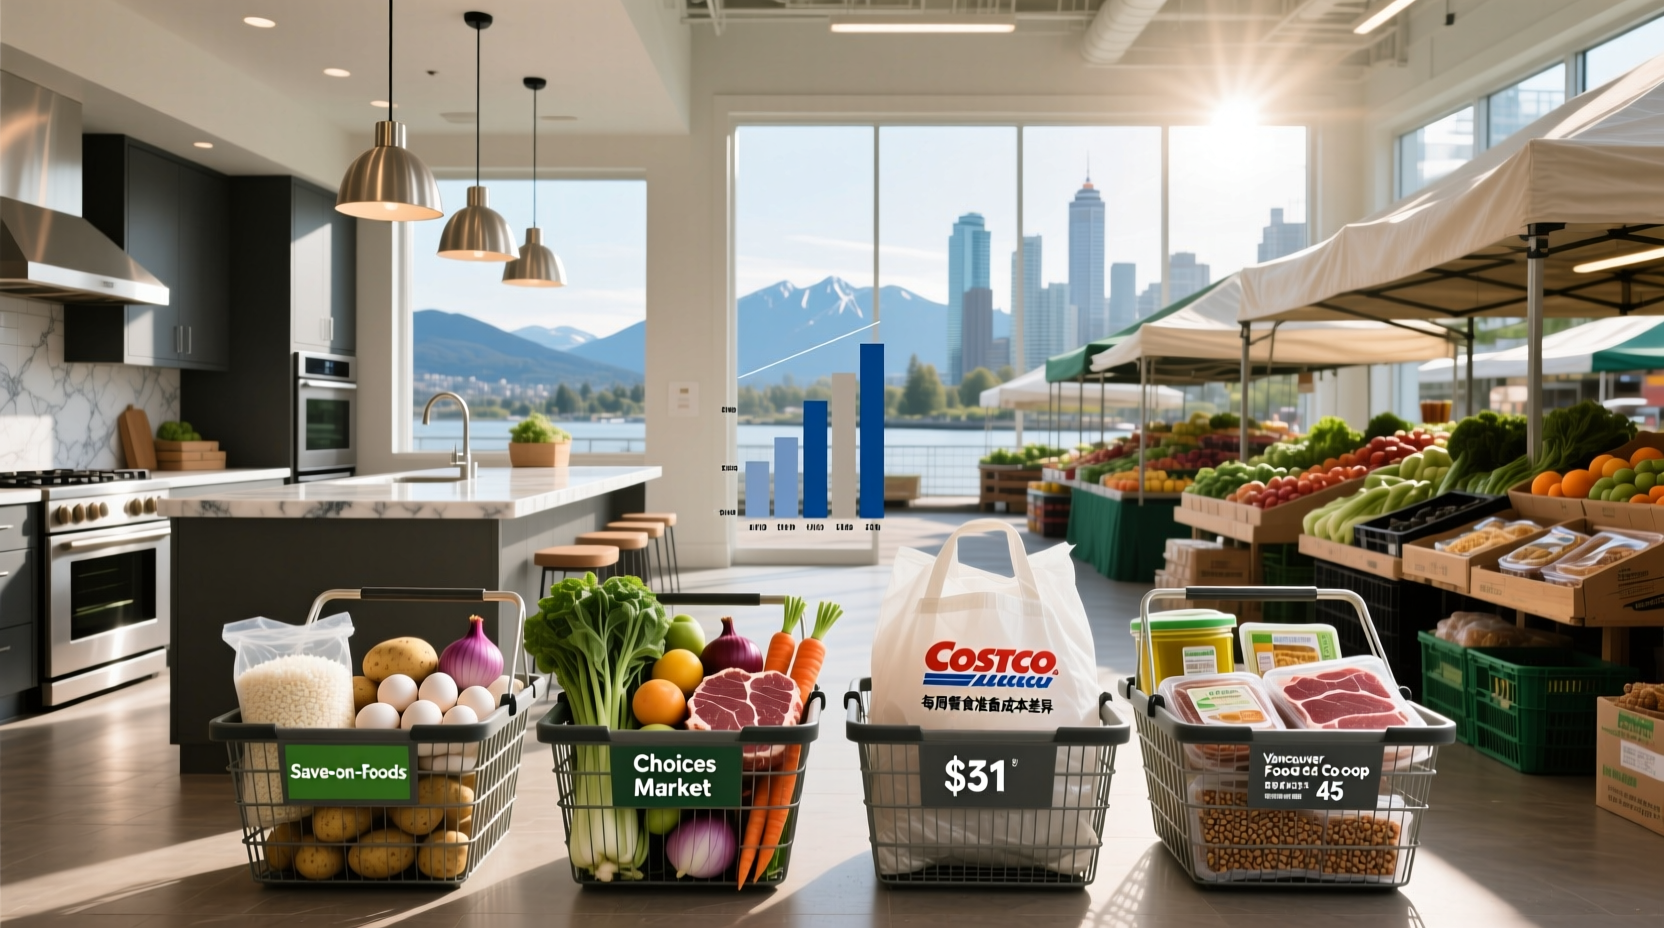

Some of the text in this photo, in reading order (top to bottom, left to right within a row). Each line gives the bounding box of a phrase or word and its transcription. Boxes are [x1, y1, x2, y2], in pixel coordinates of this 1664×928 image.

[633, 753, 717, 773] Choices
[1263, 752, 1325, 764] Vancouver
[290, 763, 407, 779] Save-on-Foods
[944, 755, 1004, 797] $31
[634, 778, 712, 797] Market
[1316, 780, 1344, 801] 45
